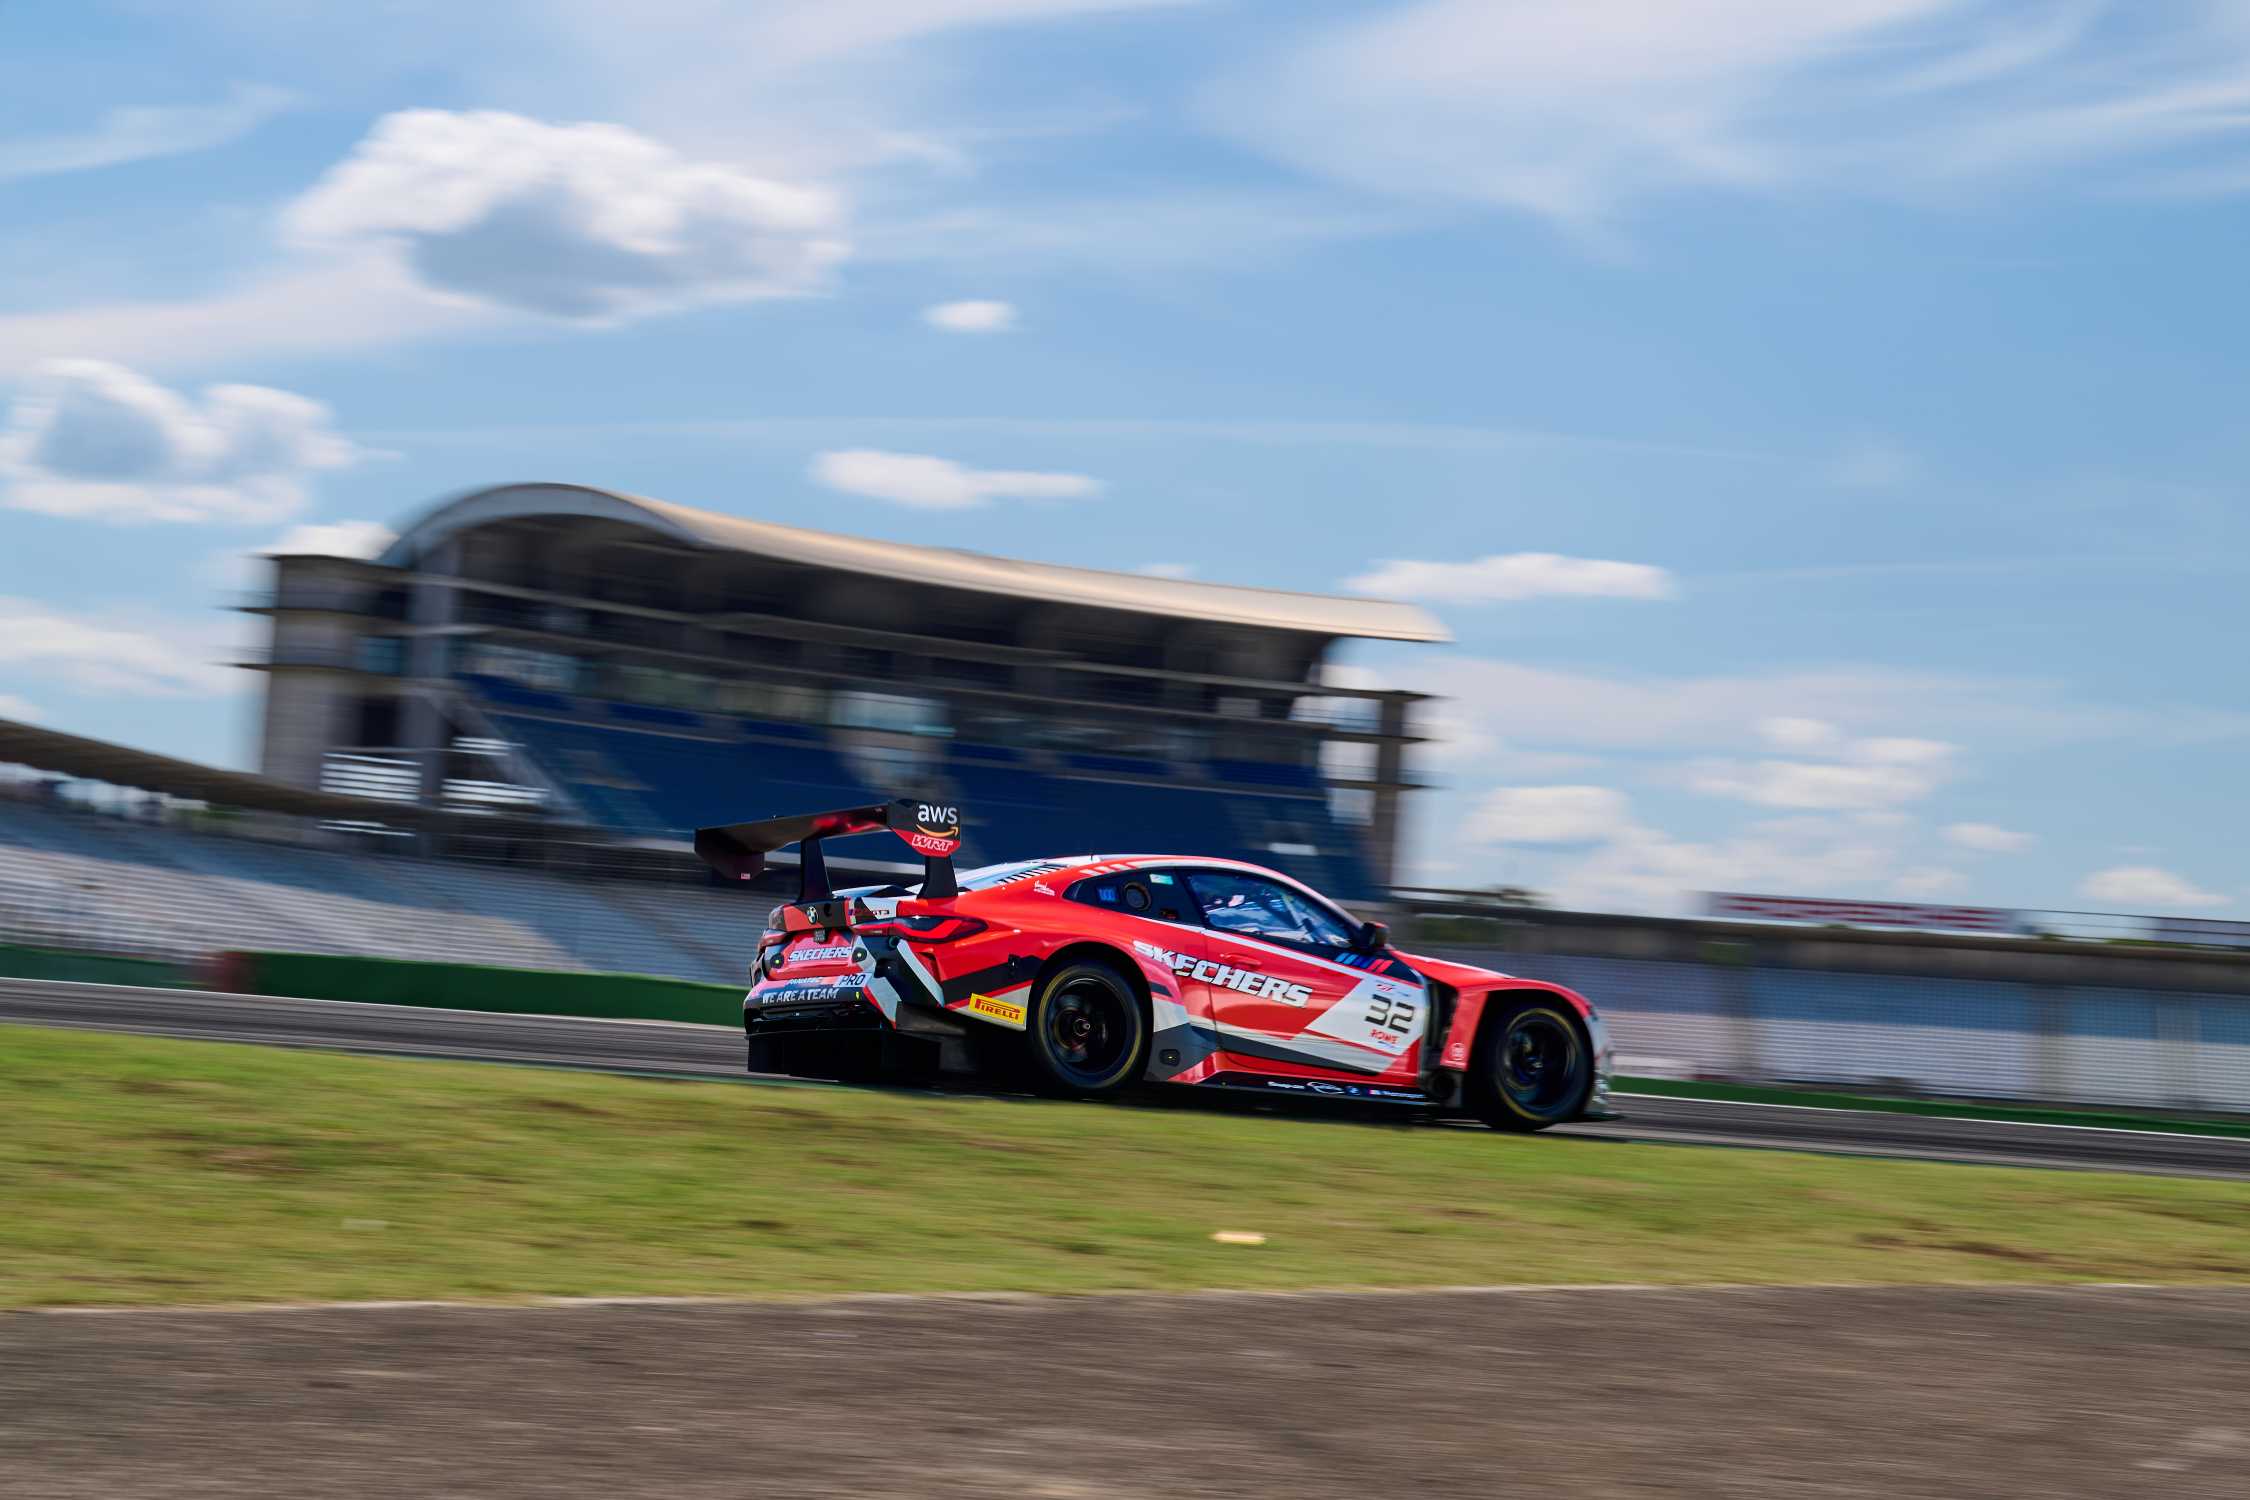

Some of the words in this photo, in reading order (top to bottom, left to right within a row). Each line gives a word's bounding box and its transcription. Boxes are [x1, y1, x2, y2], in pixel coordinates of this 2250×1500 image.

[917, 804, 958, 824] aws
[788, 946, 853, 962] SKECHERS
[838, 974, 866, 986] PRO
[1132, 940, 1313, 1008] SKECHERS
[762, 992, 775, 1004] WE
[776, 990, 796, 1003] ARE
[797, 990, 806, 1001] A
[806, 988, 841, 1001] TEAM
[974, 998, 1021, 1020] PIRELLI
[1364, 994, 1416, 1034] 32
